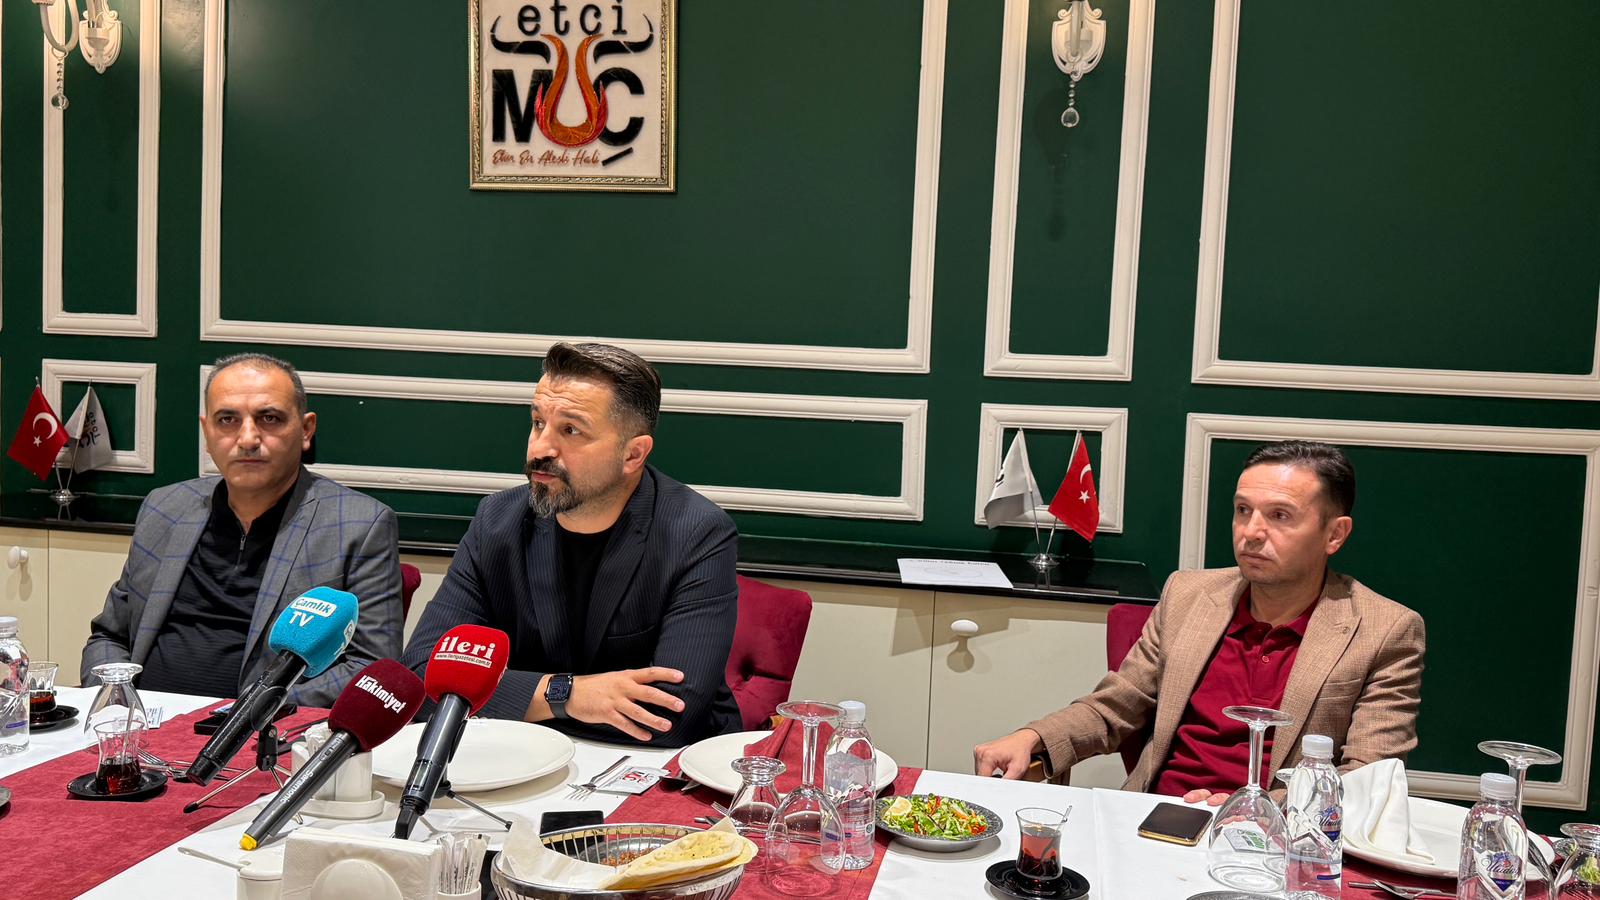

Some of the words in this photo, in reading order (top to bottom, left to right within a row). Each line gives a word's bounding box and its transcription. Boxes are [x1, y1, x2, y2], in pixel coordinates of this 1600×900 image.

[289, 611, 315, 627] TV
[439, 636, 496, 660] ileri
[280, 769, 314, 804] Saramonic
